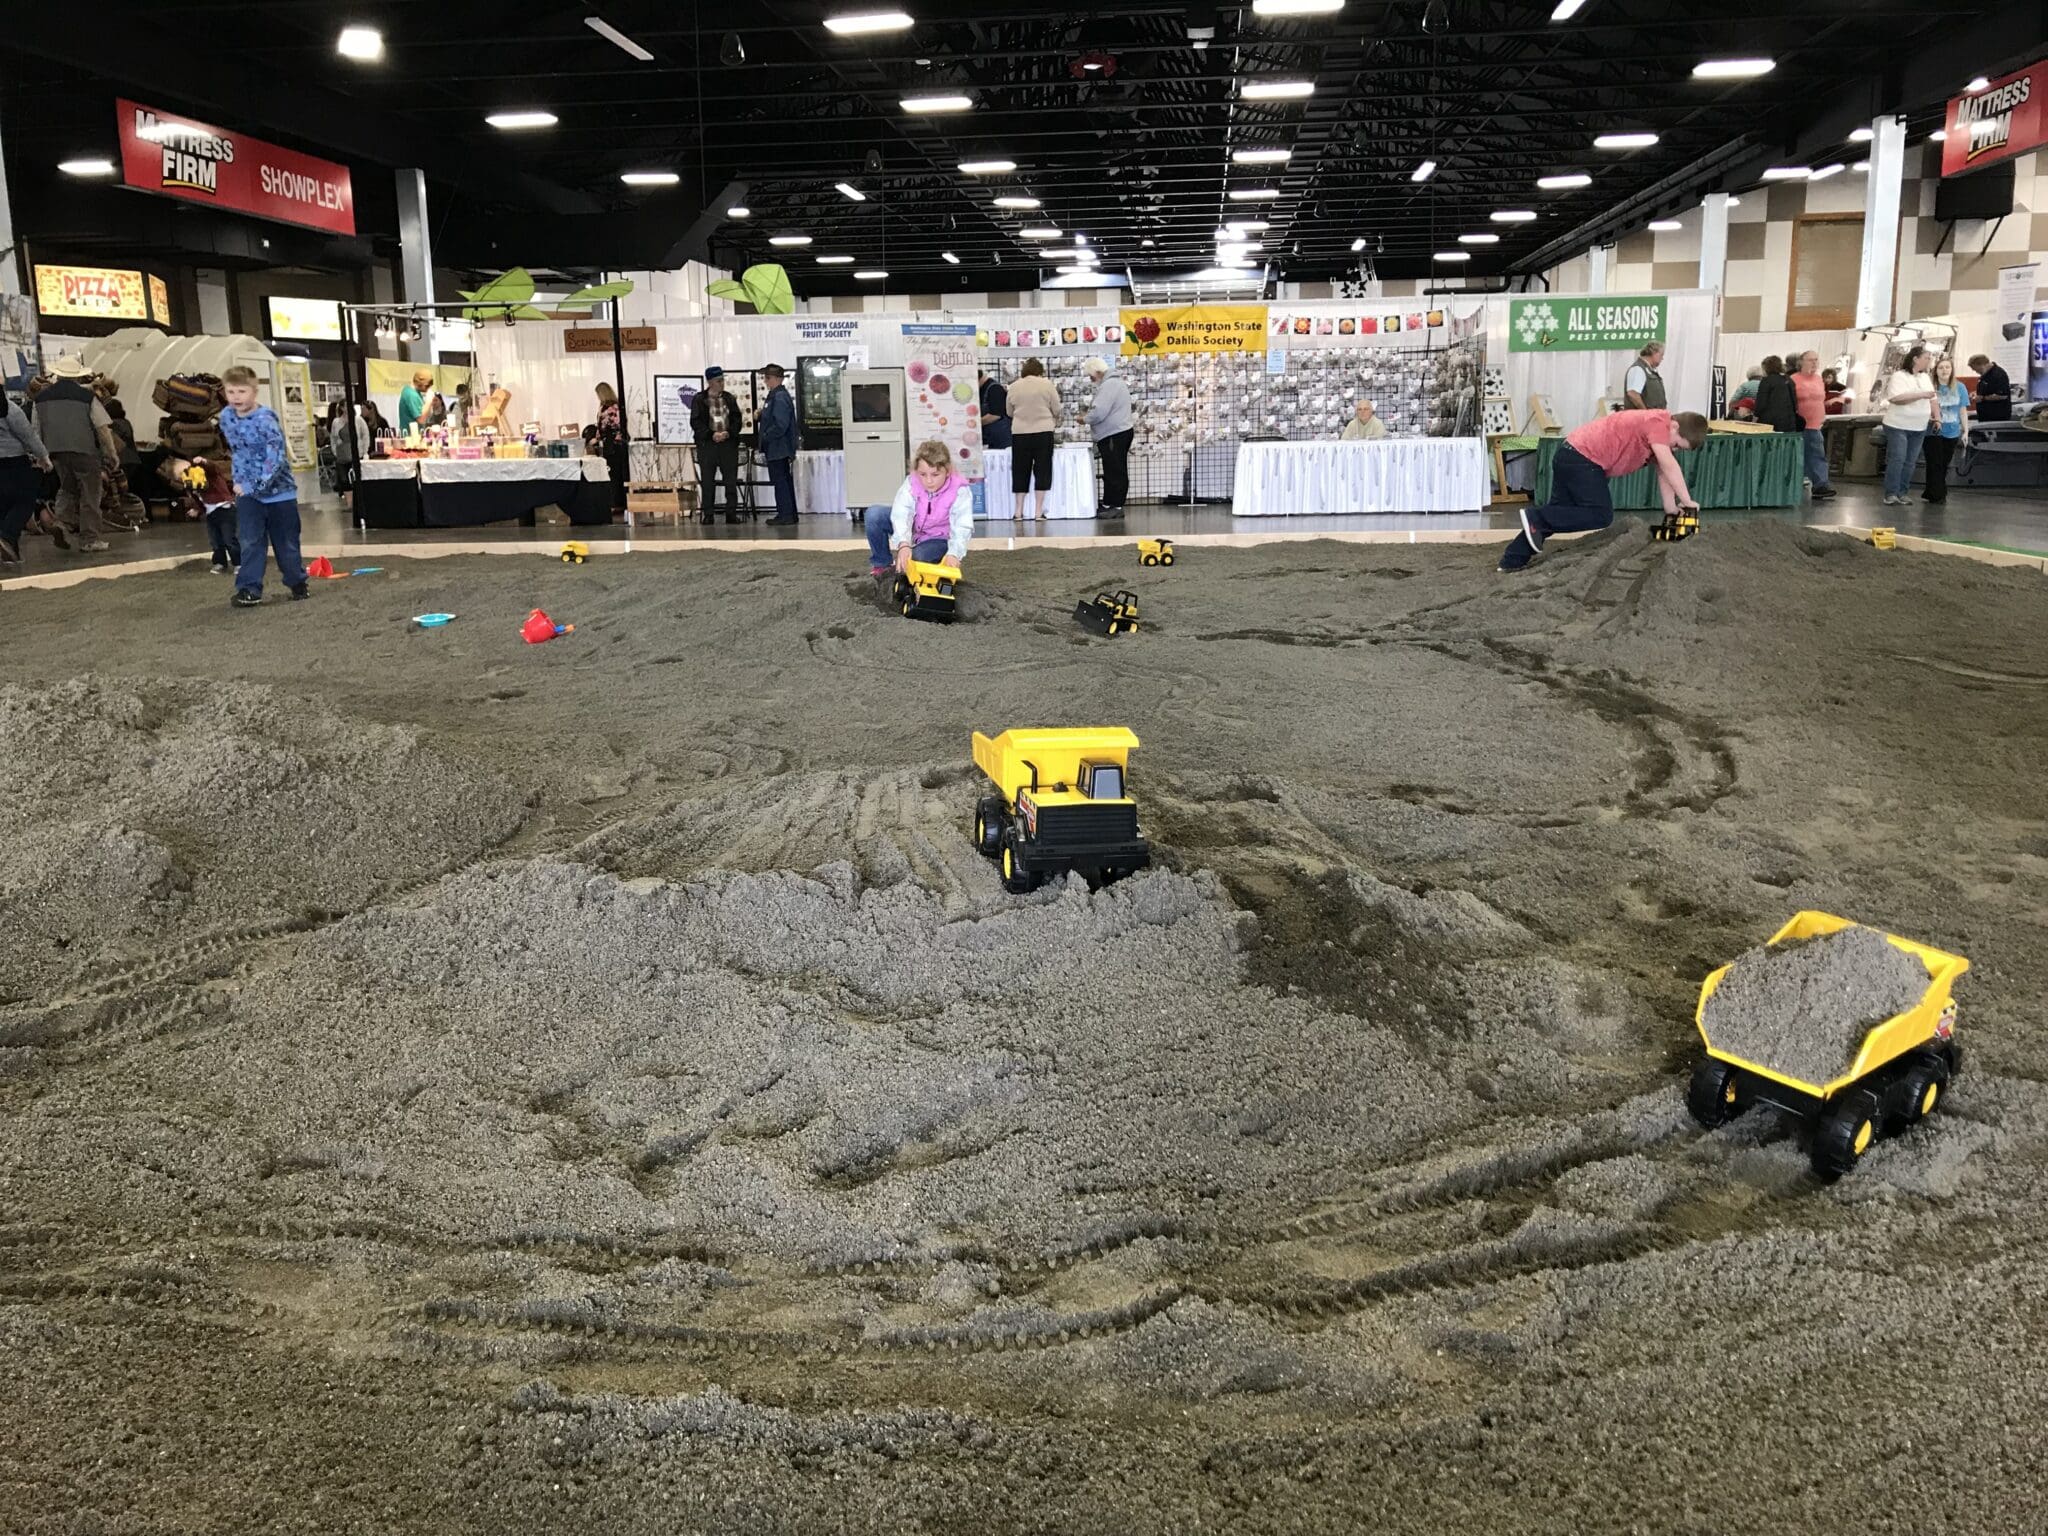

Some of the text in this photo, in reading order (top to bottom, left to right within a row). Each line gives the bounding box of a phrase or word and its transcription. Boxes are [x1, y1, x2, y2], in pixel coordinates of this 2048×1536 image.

[1957, 76, 2031, 127] MATTRESS
[162, 148, 217, 189] FIRM
[260, 164, 345, 212] SHOWPLEX
[63, 275, 121, 305] PIZZA
[795, 321, 858, 330] WESTERN CASCADE
[1568, 305, 1659, 331] ALL SEASONS
[824, 330, 852, 338] SOCIETY
[1167, 321, 1262, 334] Washington State
[1167, 335, 1244, 347] Dahlia Society
[1569, 332, 1657, 341] PEST CONTROL
[933, 352, 973, 368] DAHLIA
